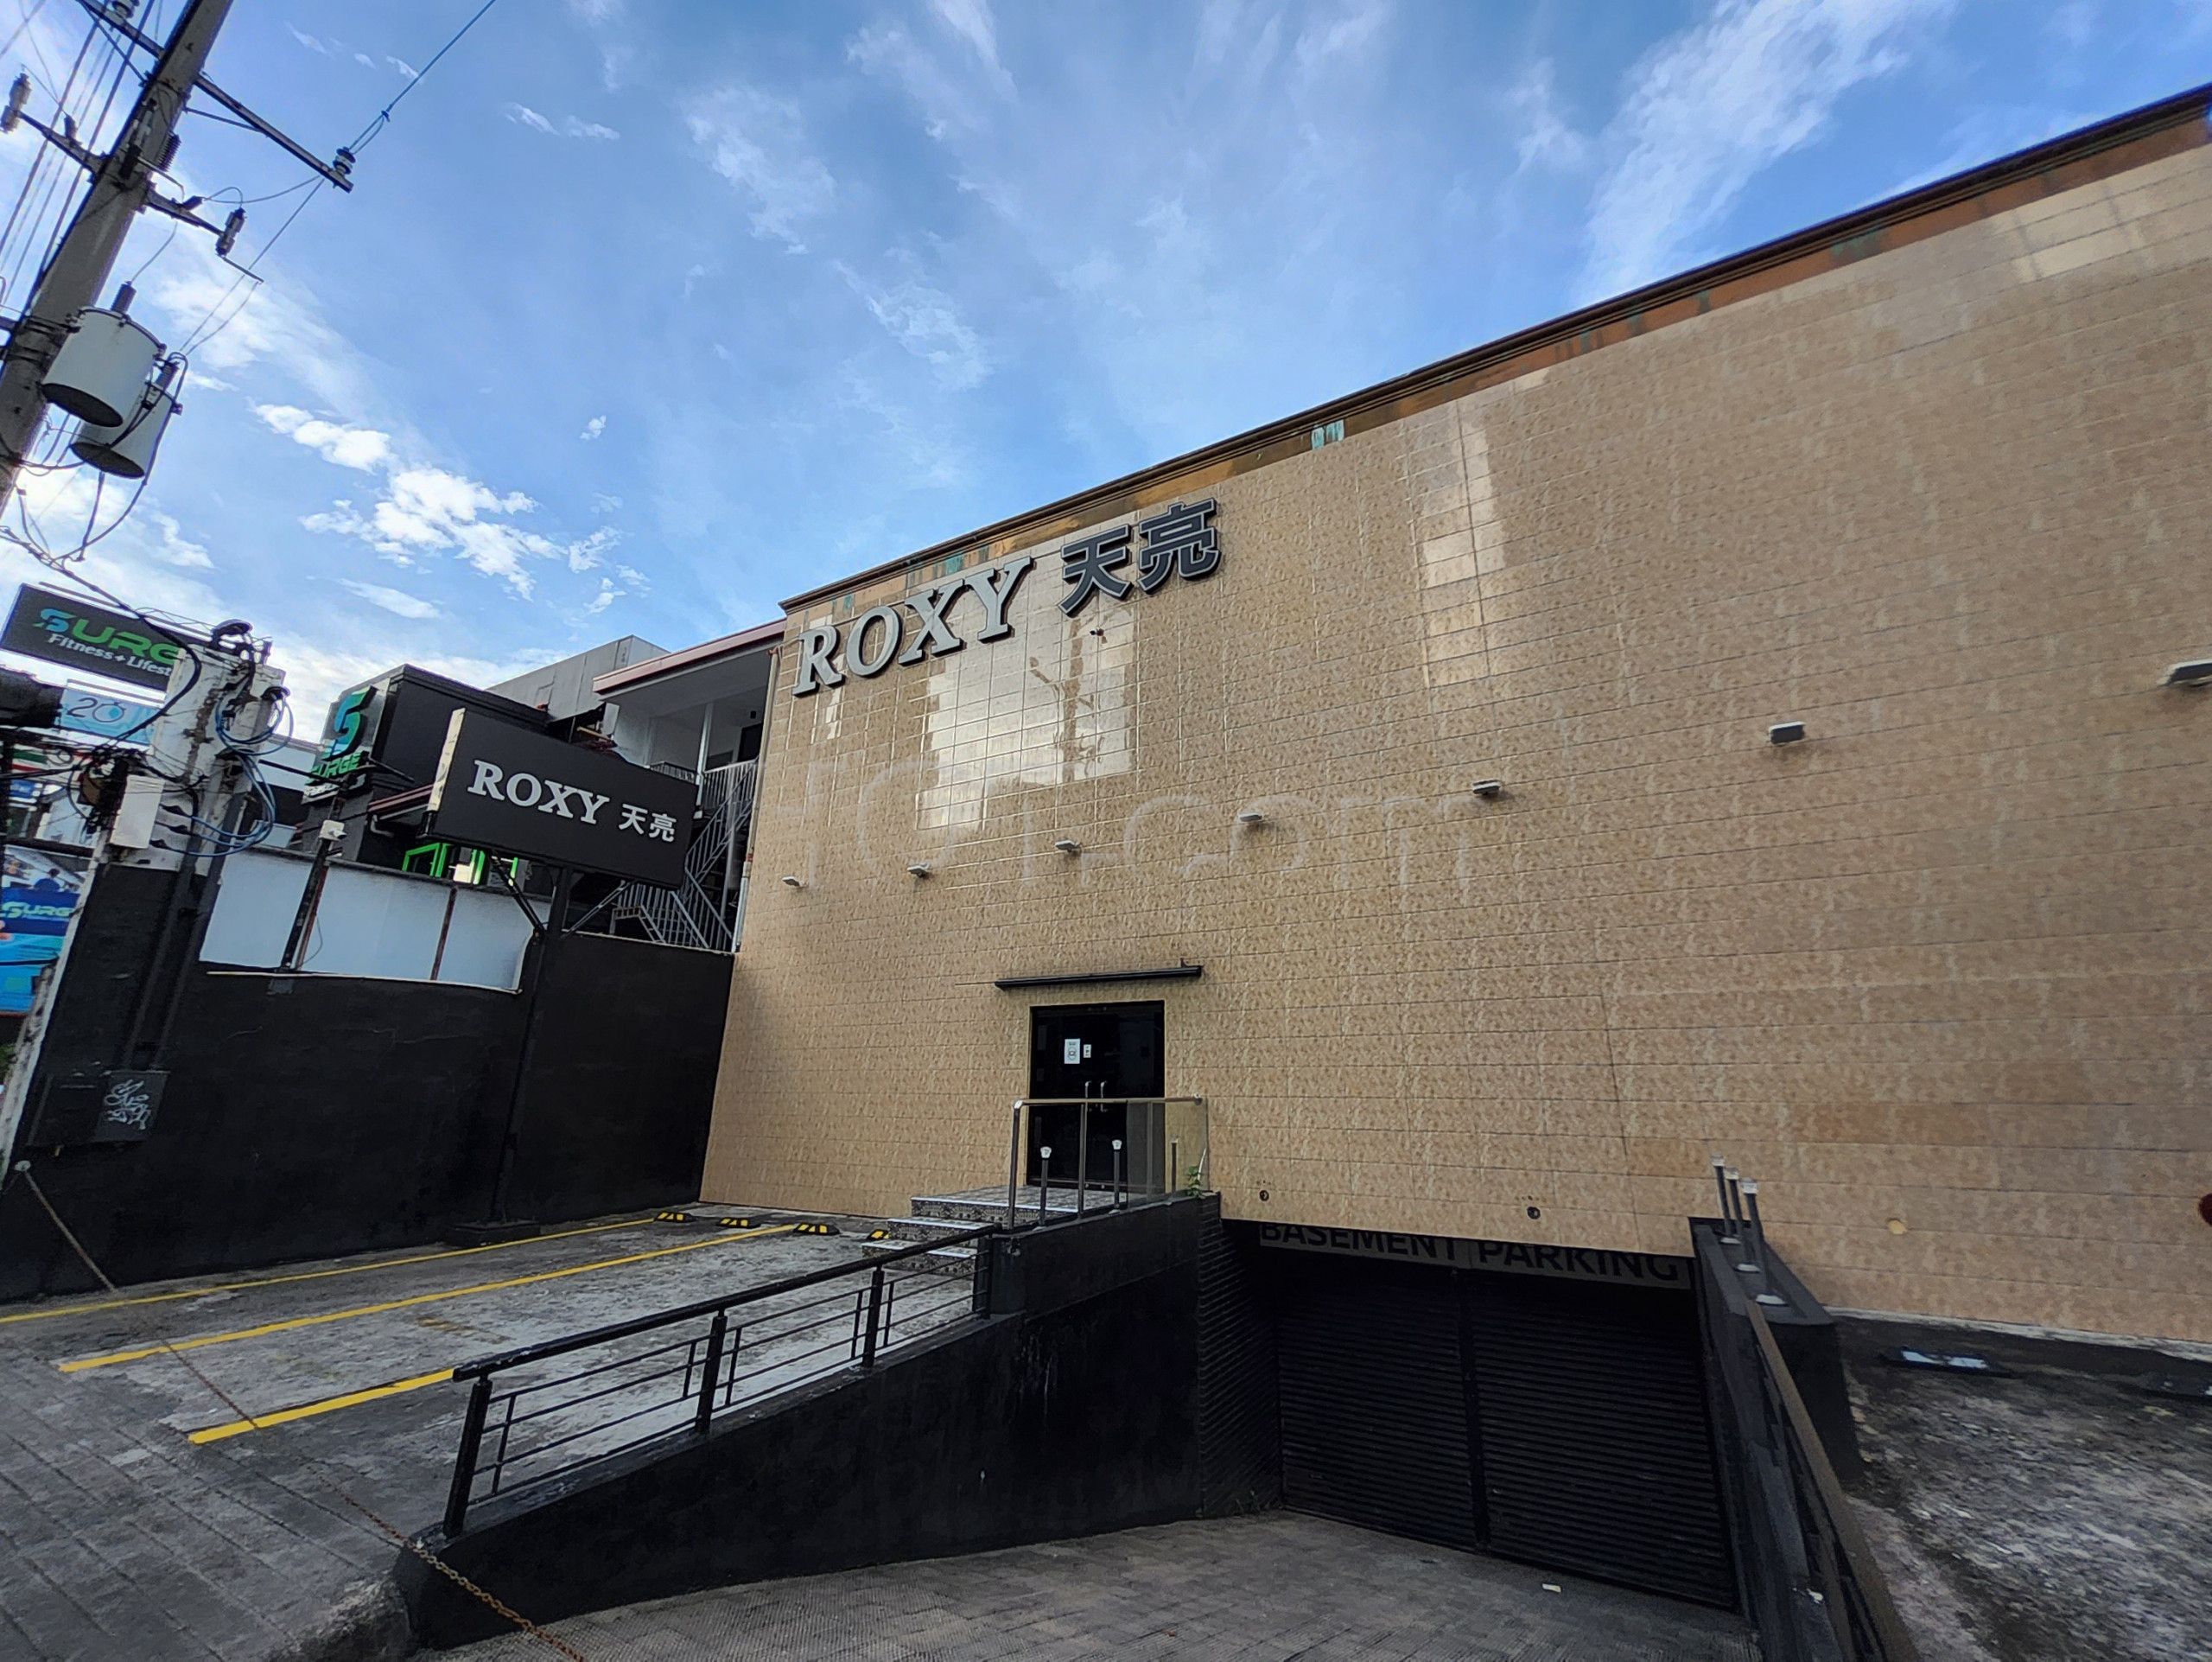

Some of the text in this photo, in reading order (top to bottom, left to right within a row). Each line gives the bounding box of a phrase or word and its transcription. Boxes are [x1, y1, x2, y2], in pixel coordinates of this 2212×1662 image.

[792, 498, 1221, 697] ROXY 天亮
[33, 608, 179, 665] SURG
[48, 633, 114, 659] Fitness
[126, 656, 173, 676] Lifest
[467, 760, 677, 843] ROXY 天亮
[2, 901, 73, 920] SURG
[1262, 1224, 1679, 1281] BASEMENT PARKING
